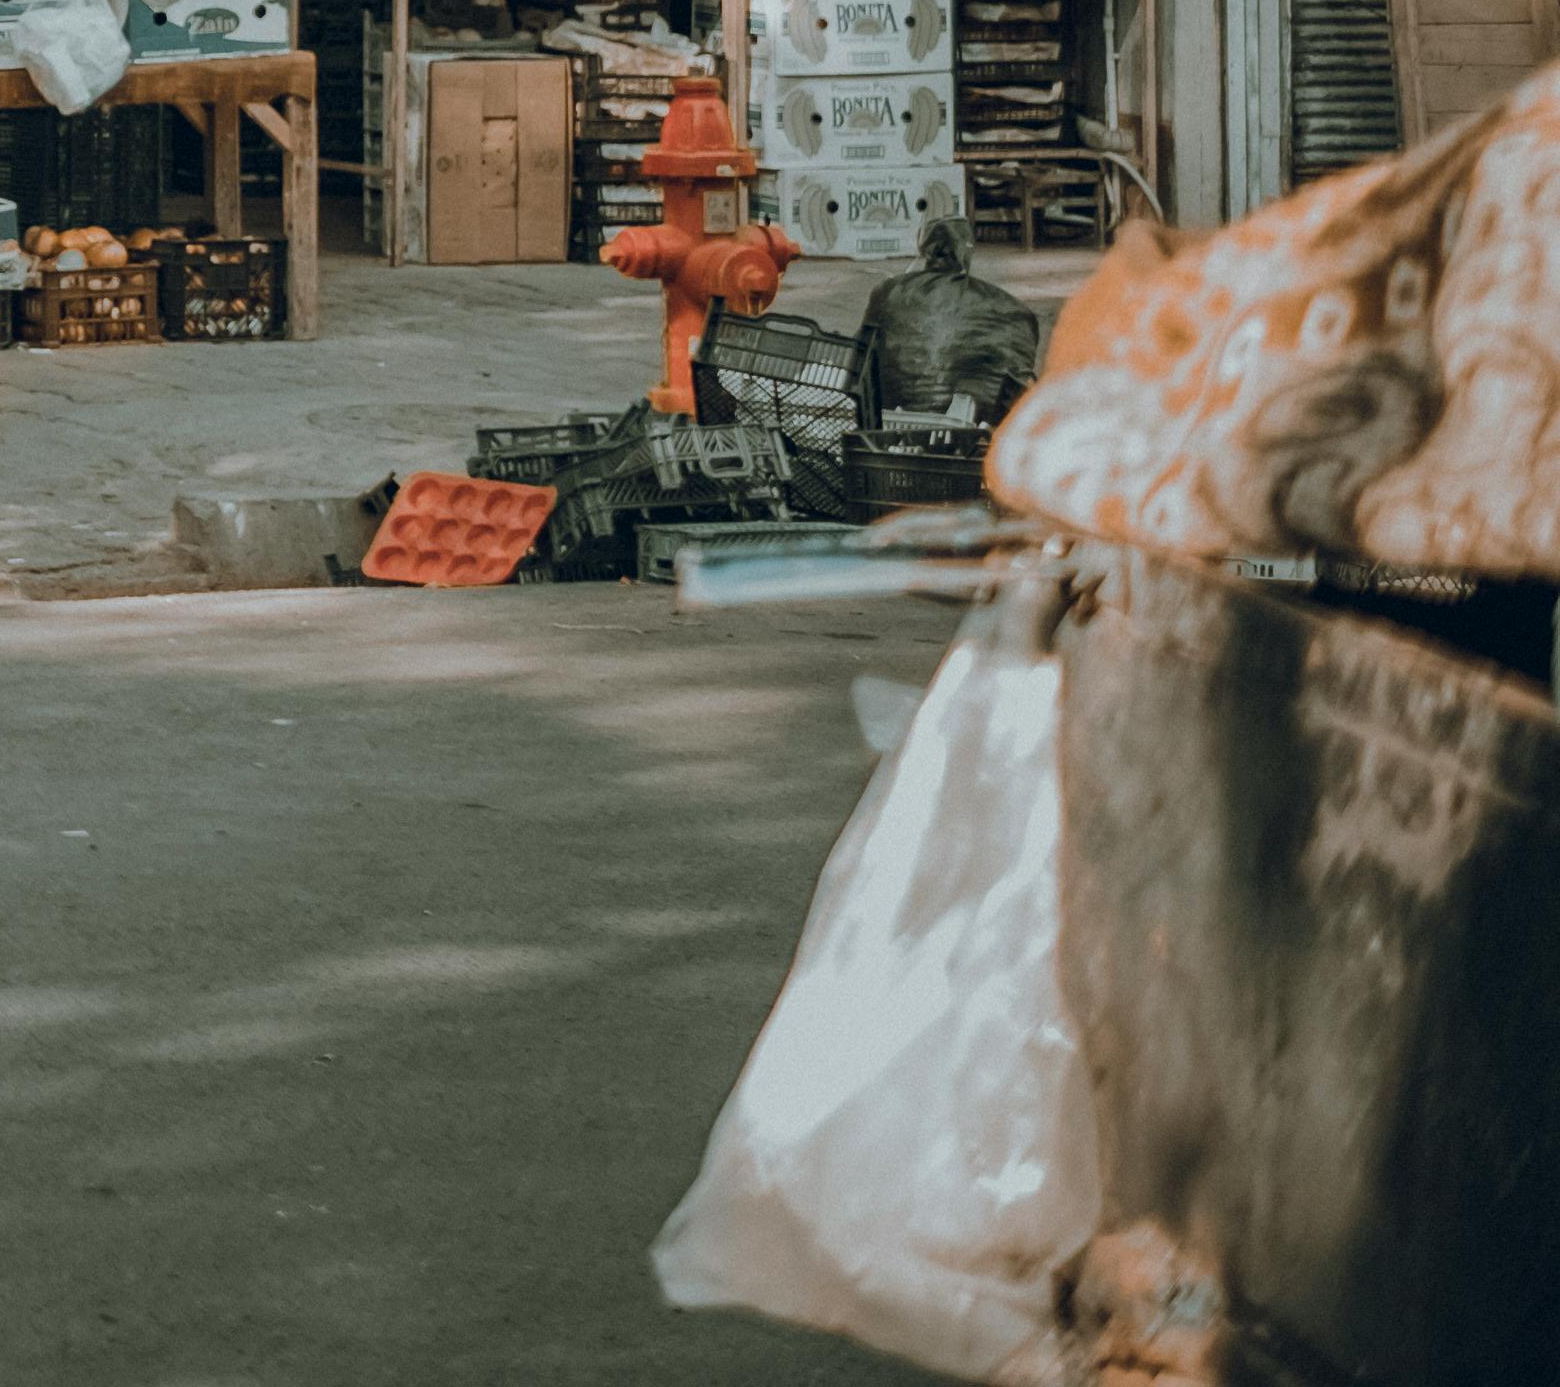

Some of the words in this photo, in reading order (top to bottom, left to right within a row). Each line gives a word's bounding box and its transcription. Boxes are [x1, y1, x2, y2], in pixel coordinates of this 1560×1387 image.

[835, 3, 898, 34] BONITA
[832, 96, 895, 129] BONITA
[848, 189, 911, 221] BONITA
